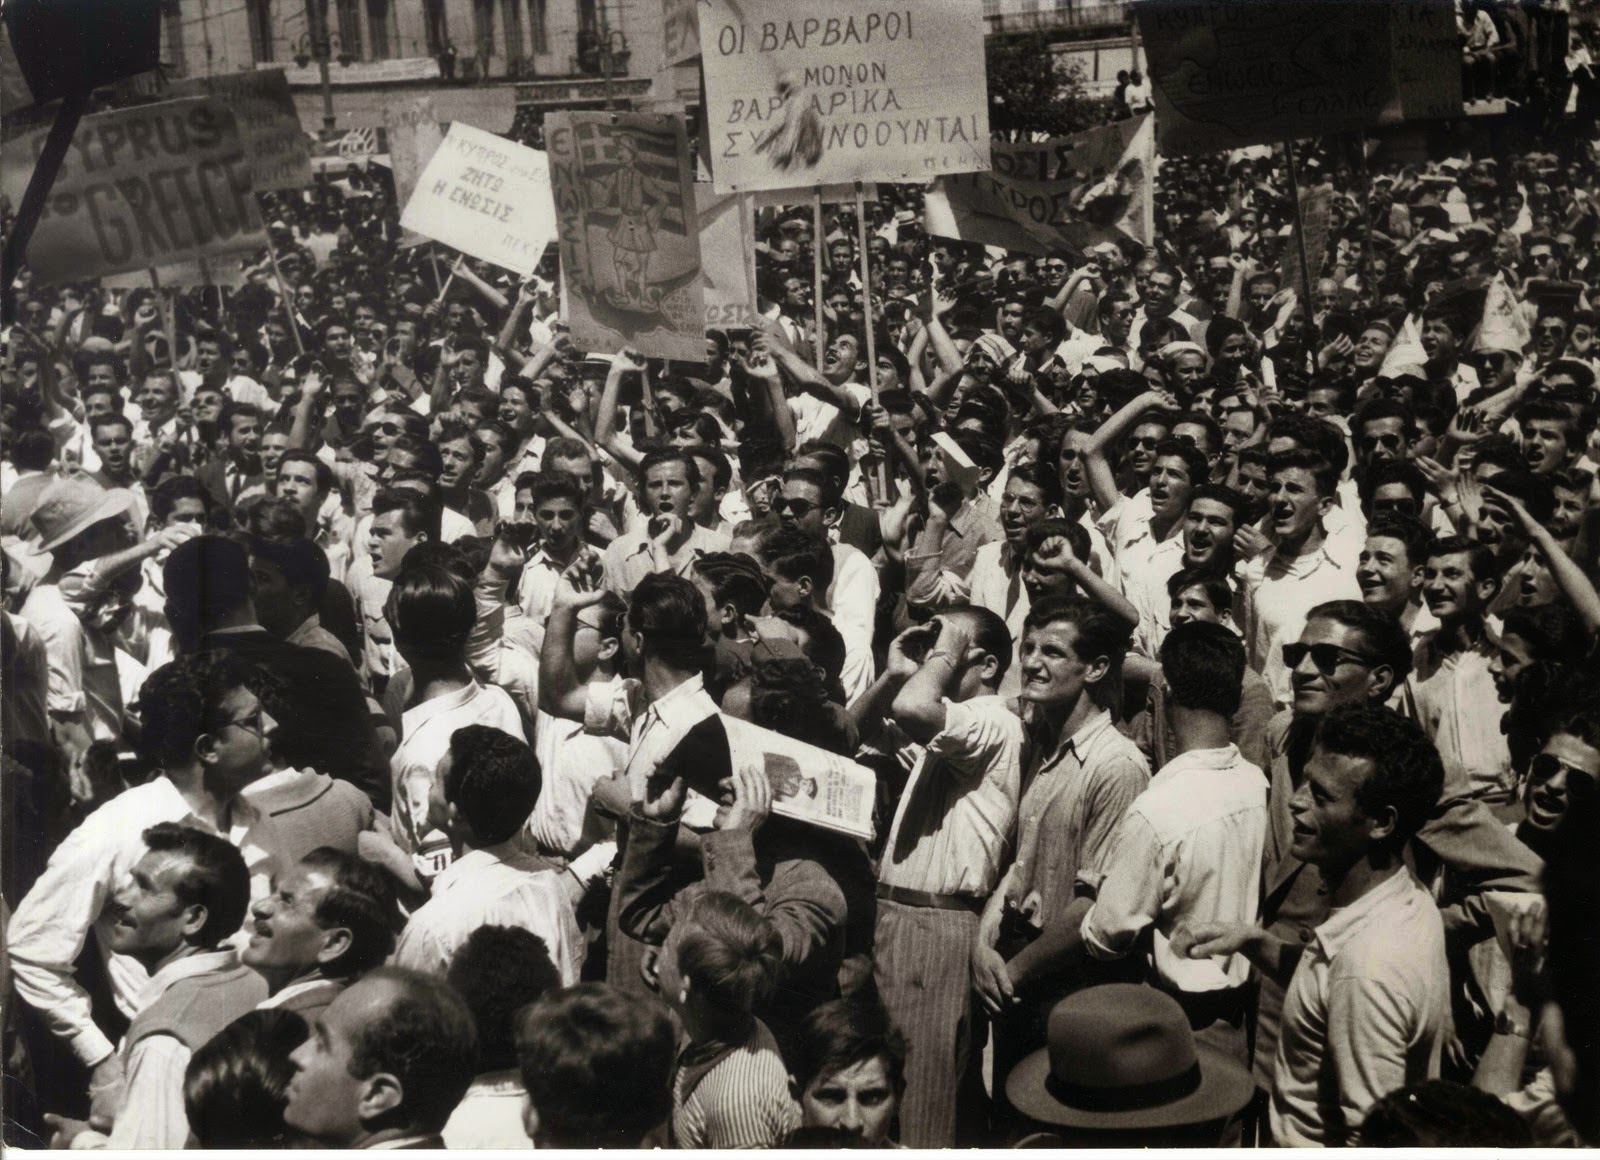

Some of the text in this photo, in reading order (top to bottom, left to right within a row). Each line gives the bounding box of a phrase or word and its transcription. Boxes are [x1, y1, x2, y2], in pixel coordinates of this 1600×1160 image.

[719, 11, 912, 56] ΟΙ ΒΑΡΒΑΡΟΙ
[804, 62, 886, 87] ΜΟΝΟΝ
[727, 88, 902, 124] ΒΑΡΑΡΙΚΑ
[722, 115, 980, 158] ΣΥΝΟΟΥΝΤΑΙ
[459, 166, 505, 193] ΖΗΤΩ
[990, 144, 1076, 183] ΩΣΙΣ
[84, 150, 262, 267] GREECE
[432, 178, 515, 223] Η ΕΝΩΣΙΣ
